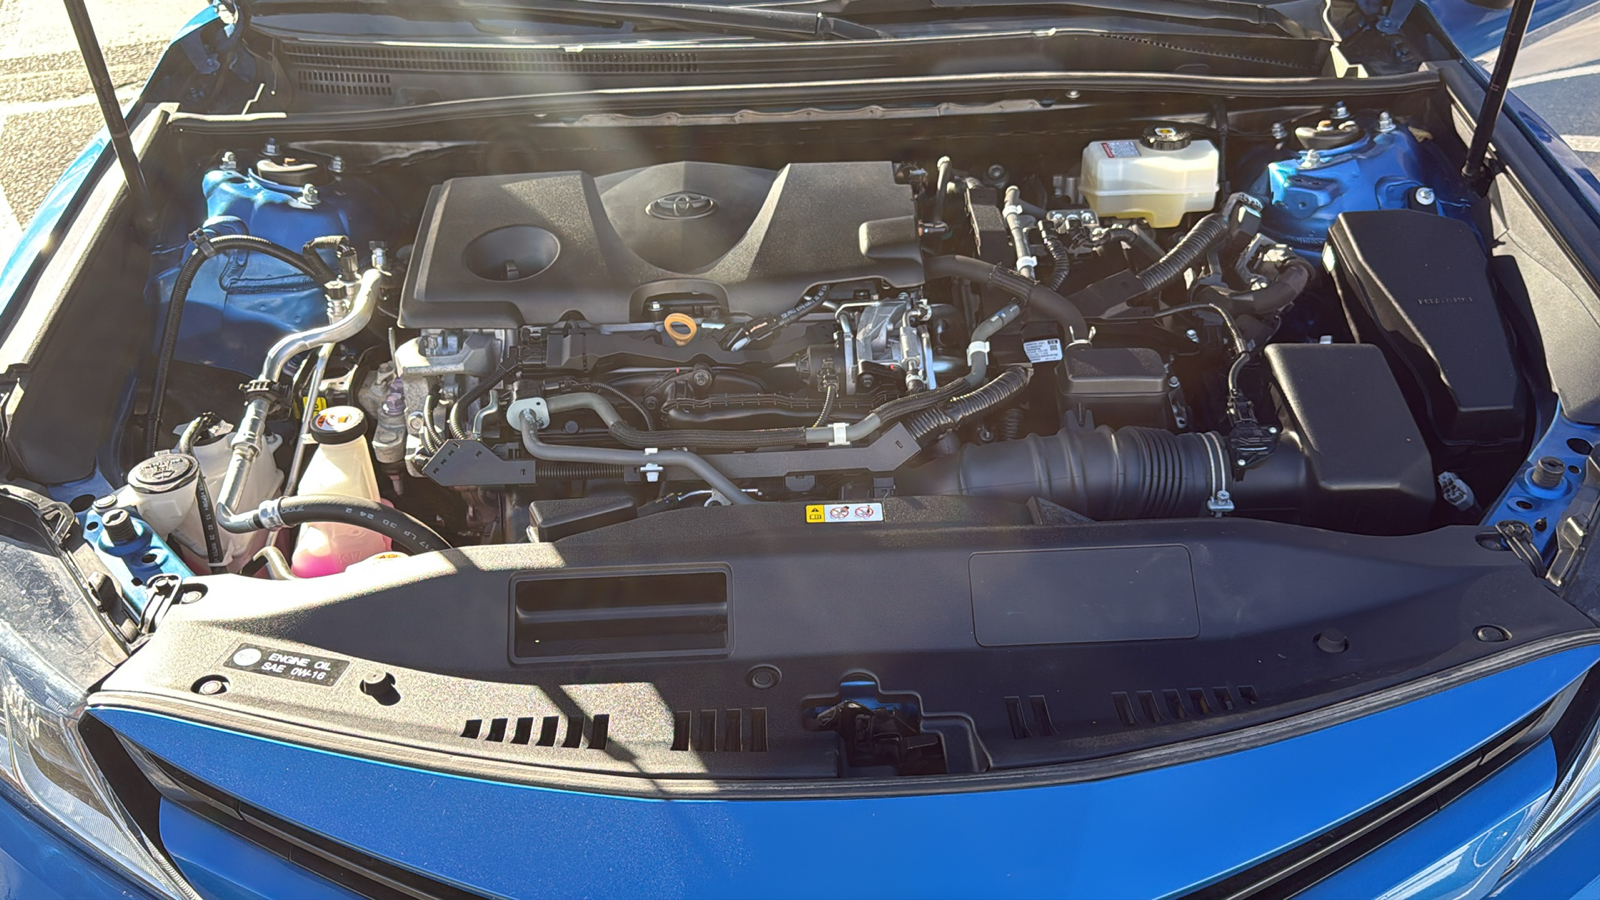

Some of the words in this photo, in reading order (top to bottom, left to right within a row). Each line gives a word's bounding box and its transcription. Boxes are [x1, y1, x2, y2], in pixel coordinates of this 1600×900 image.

[359, 511, 375, 520] 24
[383, 518, 398, 529] 3D
[403, 530, 417, 541] LP
[419, 541, 435, 552] 17
[268, 652, 311, 667] ENGINE
[314, 660, 332, 671] OIL
[261, 662, 286, 673] SAE
[290, 667, 327, 680] 0W-16
